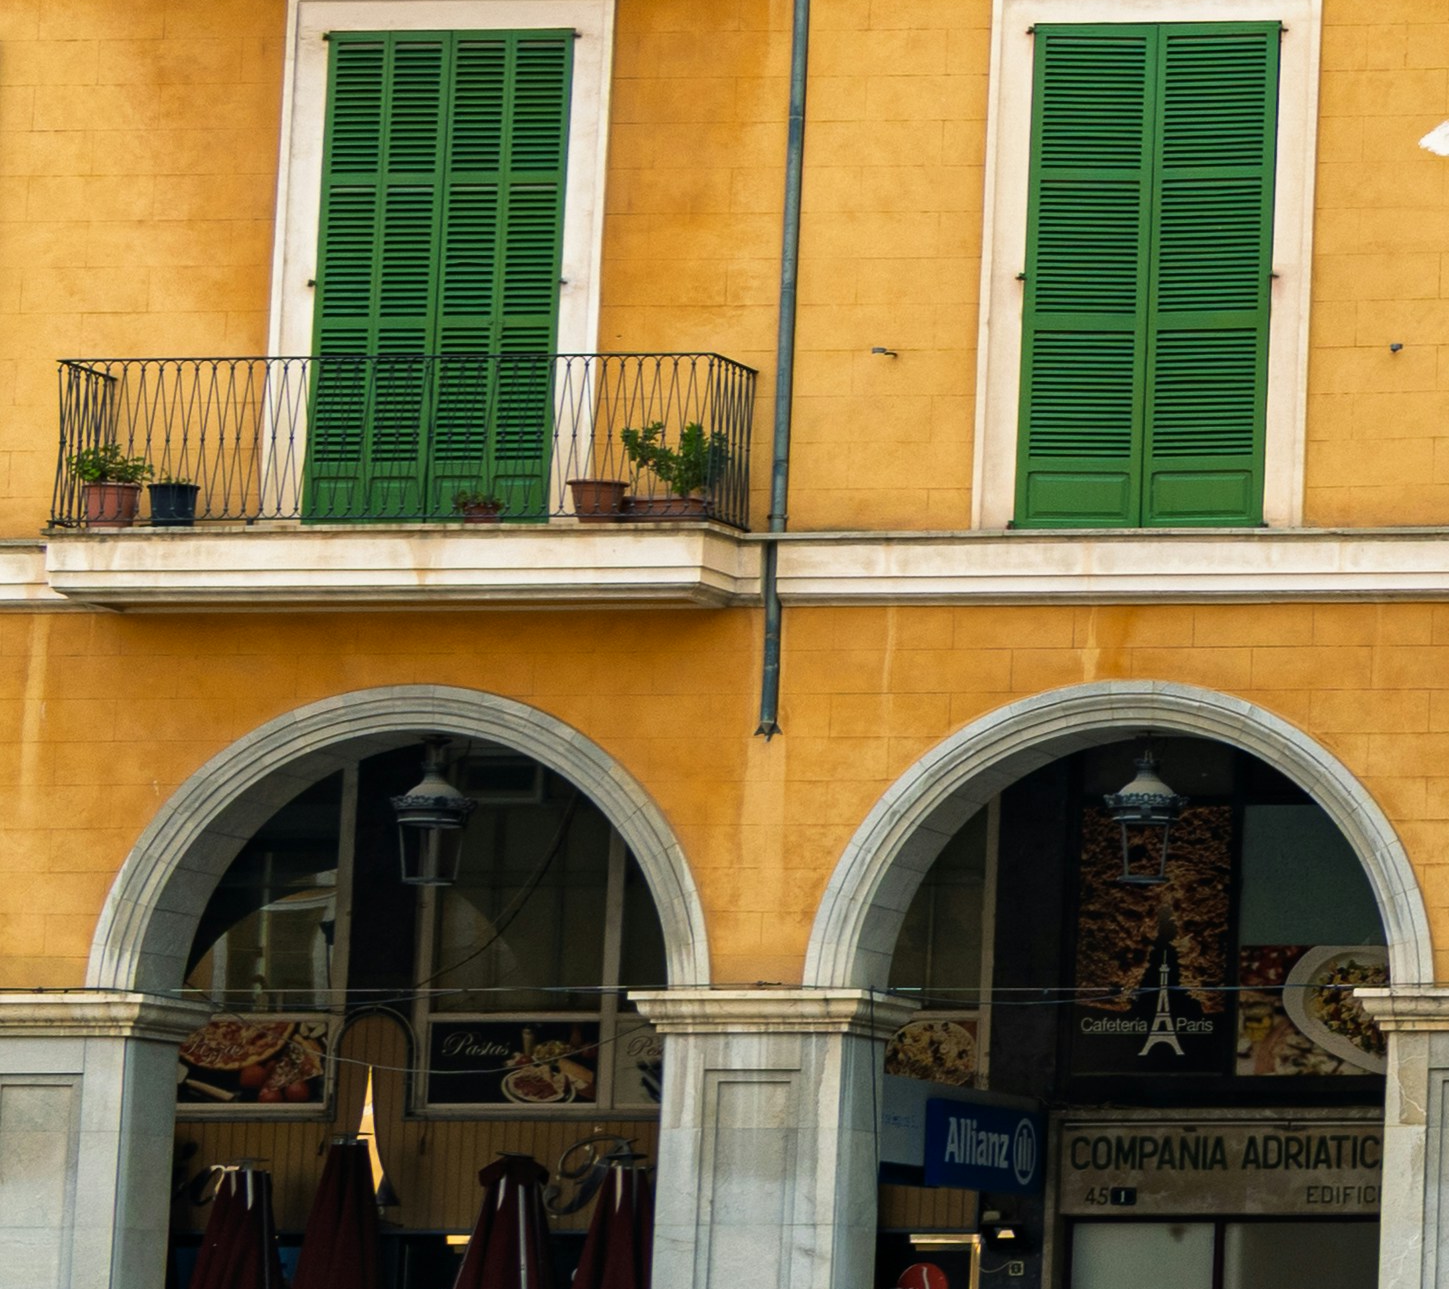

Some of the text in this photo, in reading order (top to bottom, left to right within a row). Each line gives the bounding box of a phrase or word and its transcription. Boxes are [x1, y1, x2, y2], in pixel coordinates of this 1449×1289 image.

[442, 1031, 510, 1058] Pastas
[944, 1116, 1010, 1170] Allianz
[1241, 1134, 1383, 1171] ADRIATIC
[1086, 1186, 1109, 1206] 45
